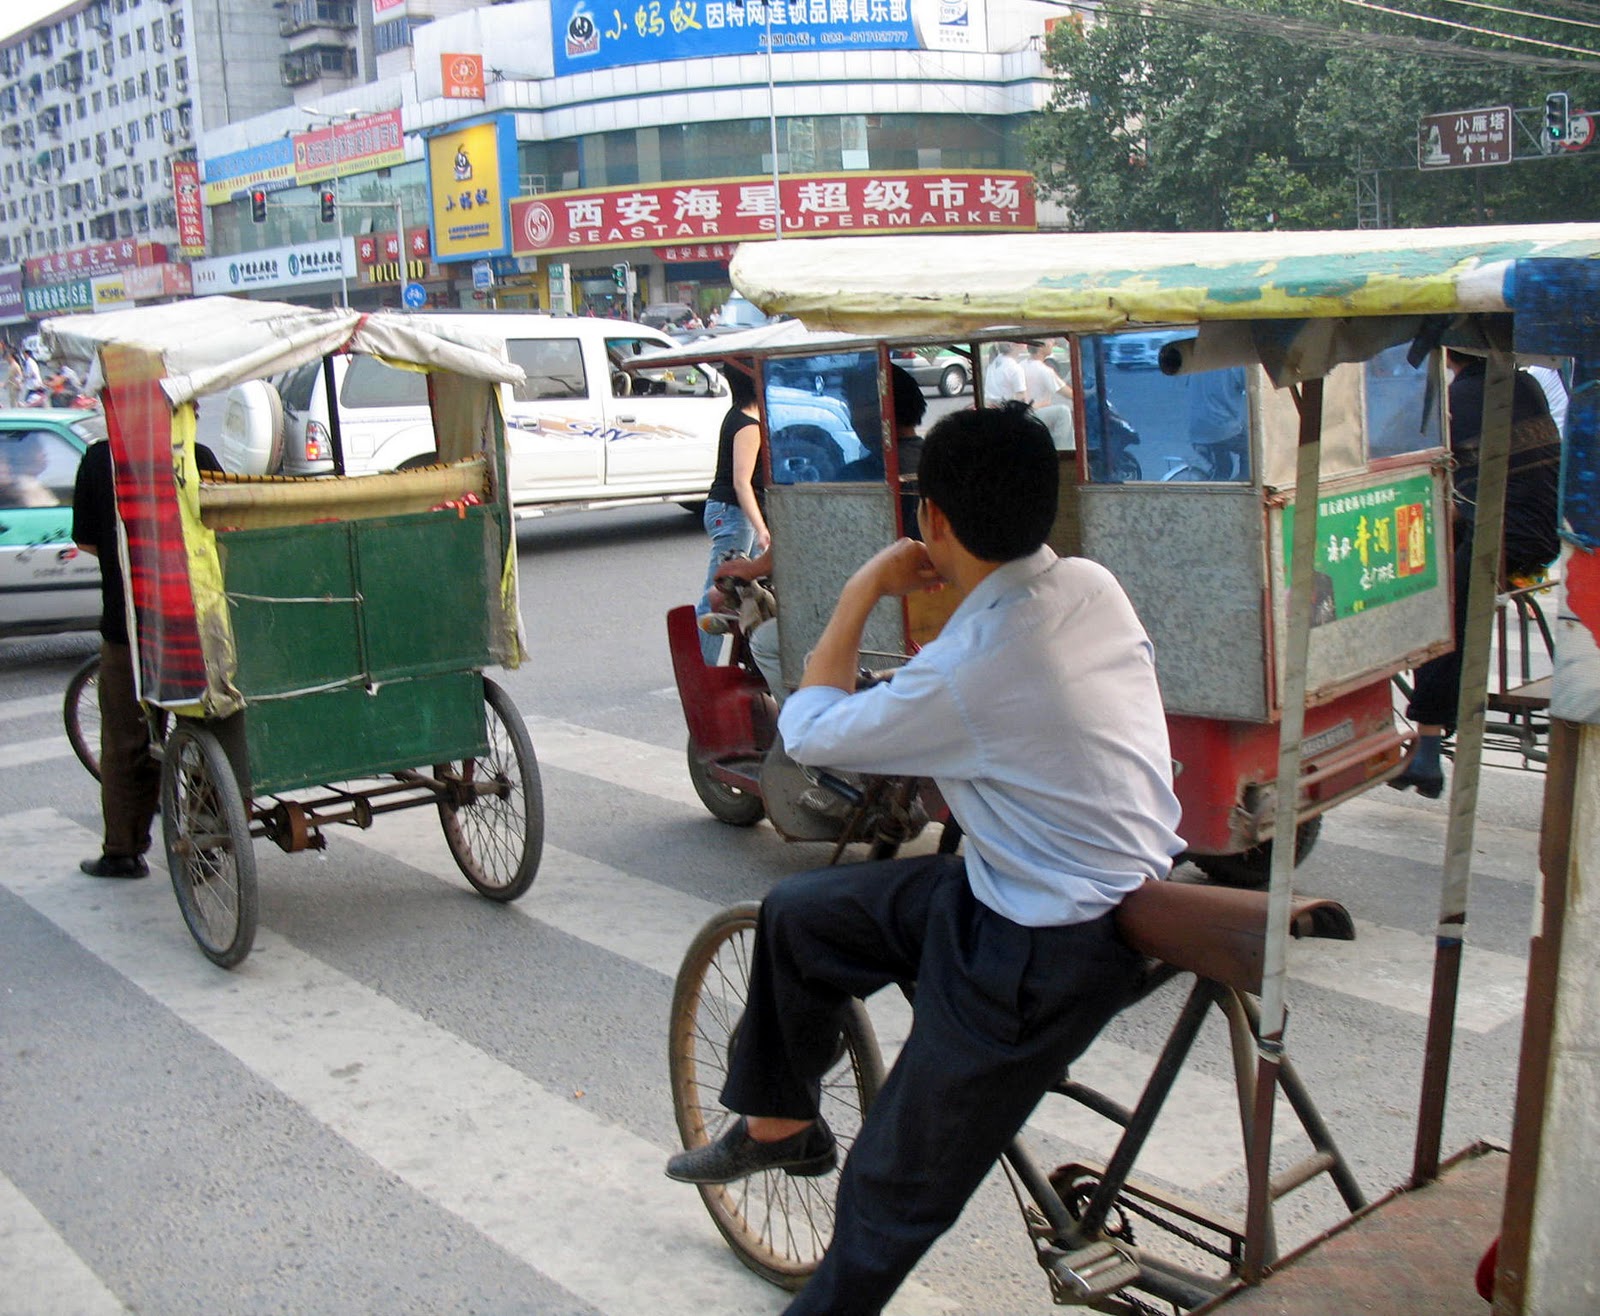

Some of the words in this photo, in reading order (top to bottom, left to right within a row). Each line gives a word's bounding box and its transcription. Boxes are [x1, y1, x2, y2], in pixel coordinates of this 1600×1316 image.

[605, 0, 702, 40] 小蚂蚁
[706, 0, 908, 28] 因特网连锁品牌俱乐部
[1454, 112, 1505, 133] 小雁塔
[1480, 147, 1485, 162] 1
[565, 178, 1020, 229] 西安海星超级市场
[568, 221, 719, 244] SEASTAR
[759, 210, 1020, 231] SUPERMARKET
[240, 260, 278, 278] 中国农业银行
[299, 250, 342, 268] 中国农业银行
[369, 259, 424, 282] HOLILND
